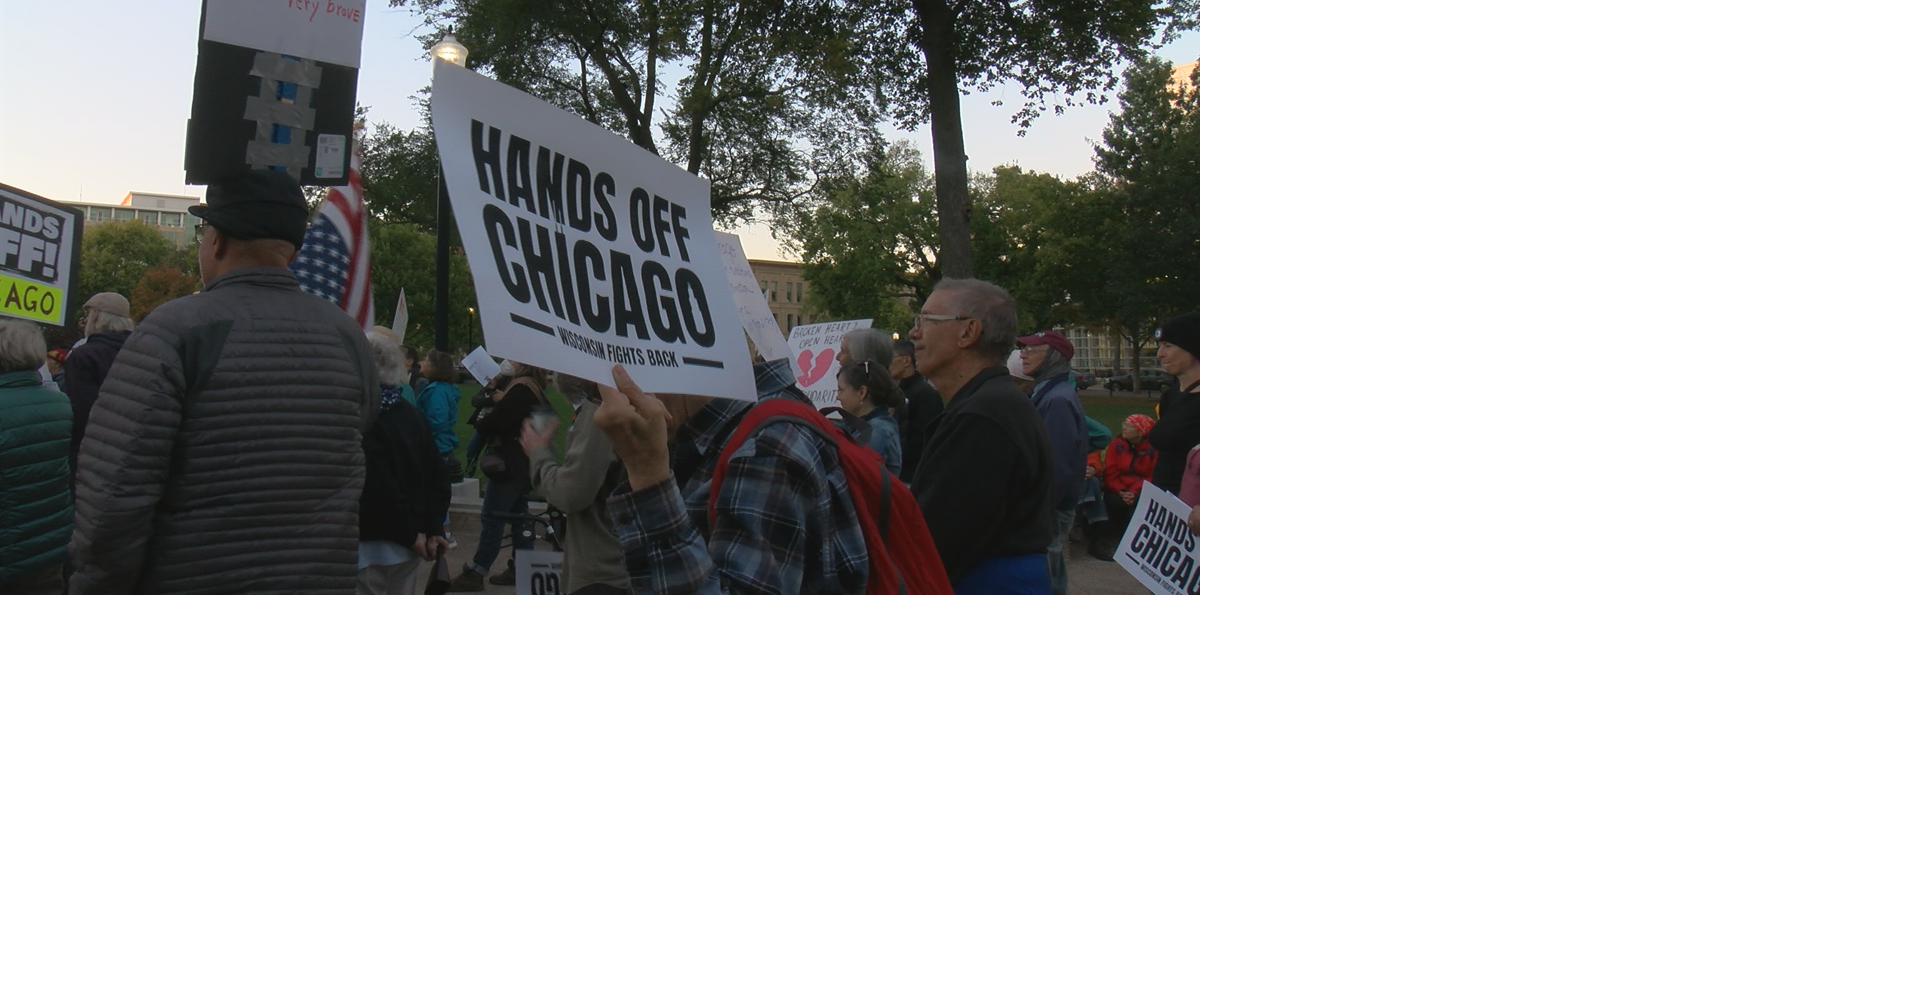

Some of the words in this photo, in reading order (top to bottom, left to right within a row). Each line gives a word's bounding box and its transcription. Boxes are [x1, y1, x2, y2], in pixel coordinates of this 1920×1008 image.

[471, 118, 618, 242] HANDS
[630, 187, 690, 262] OFF
[0, 199, 60, 240] NDS
[483, 203, 716, 348] CHICAGO
[0, 281, 55, 316] AGO
[557, 326, 606, 360] WISCONSIN
[608, 346, 645, 366] FIGHTS
[648, 349, 679, 368] BACK
[793, 325, 822, 339] BROKEN
[799, 337, 820, 349] OPEN
[1144, 498, 1195, 553] HANDS
